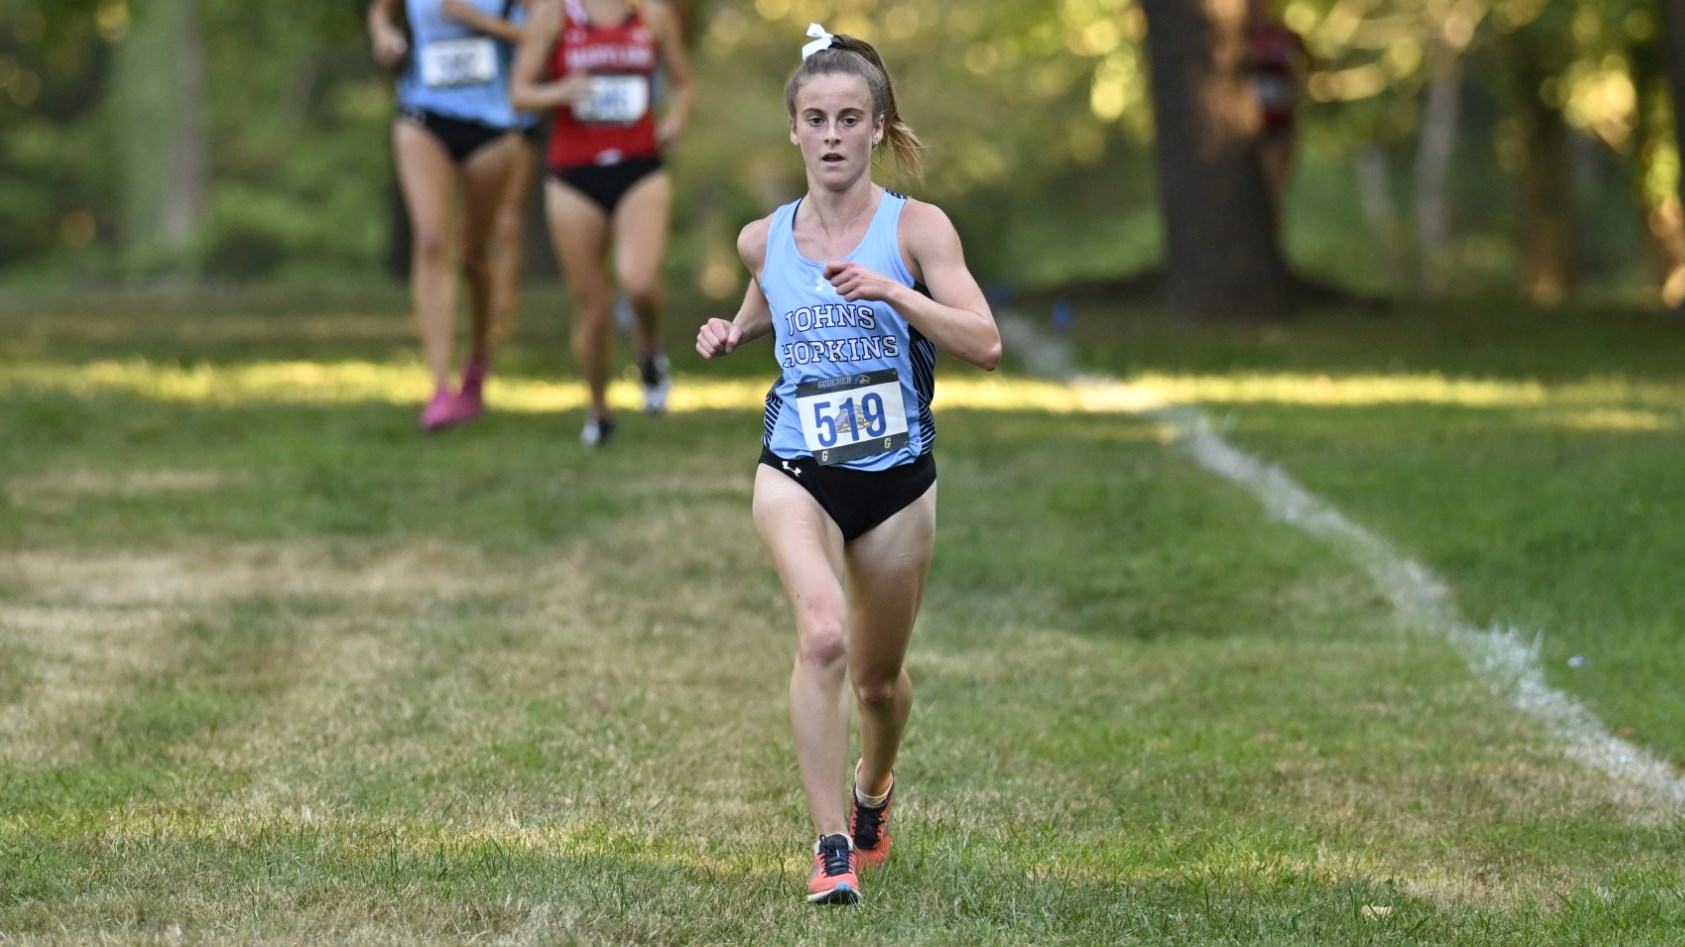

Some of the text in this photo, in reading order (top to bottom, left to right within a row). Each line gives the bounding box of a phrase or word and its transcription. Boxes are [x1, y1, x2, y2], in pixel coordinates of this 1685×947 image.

[785, 304, 875, 336] JOHNS
[783, 336, 899, 368] HOPKINS
[818, 376, 852, 389] GOUCHER
[814, 392, 886, 447] 519
[884, 437, 892, 449] G
[822, 450, 829, 462] G
